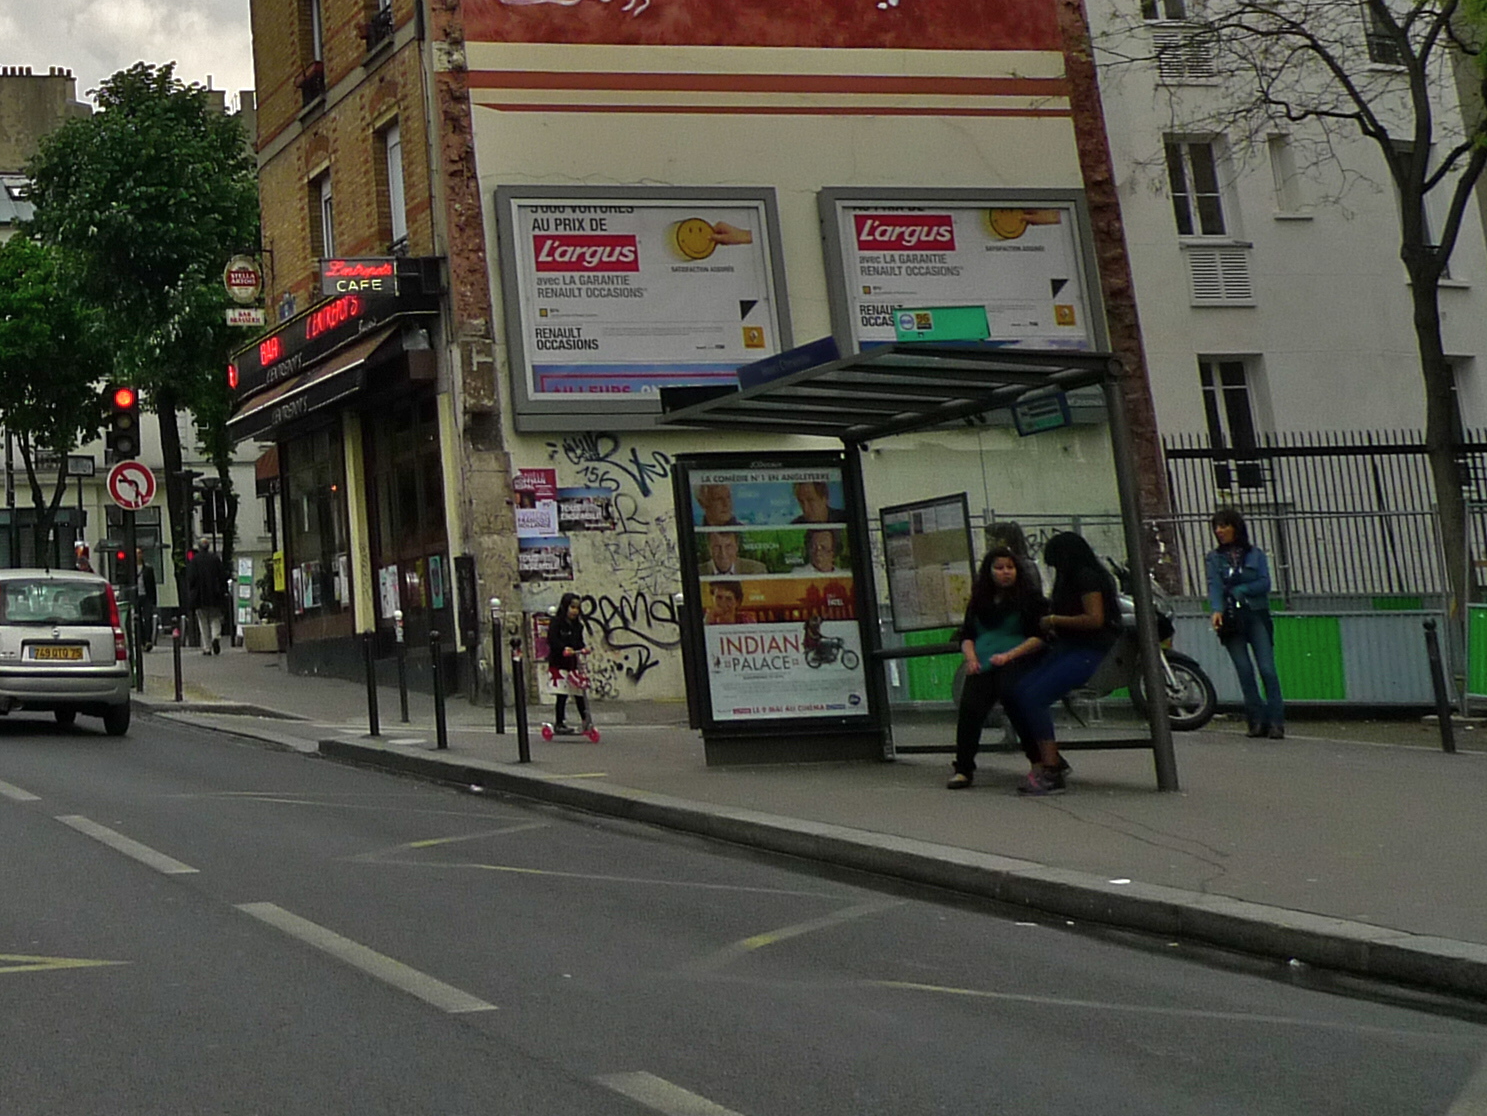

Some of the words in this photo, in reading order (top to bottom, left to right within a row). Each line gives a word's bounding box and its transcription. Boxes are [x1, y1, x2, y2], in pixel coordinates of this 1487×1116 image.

[532, 217, 550, 232] AU
[554, 217, 586, 232] PRIX
[589, 217, 608, 232] DE
[859, 219, 952, 246] L'argus
[537, 239, 636, 267] L'argus
[883, 253, 897, 264] LA
[898, 253, 947, 264] GARANTIE
[860, 265, 903, 276] RENAULT
[336, 279, 383, 292] CAFE
[536, 276, 560, 286] avec
[562, 275, 577, 286] LA
[578, 274, 630, 286] GARANTIE
[537, 287, 583, 298] RENAULT
[859, 304, 903, 315] RENAU
[861, 315, 895, 327] OCCAS
[535, 327, 582, 339] RENAULT
[536, 338, 599, 350] OCCASIONS
[701, 475, 712, 483] LA
[781, 473, 829, 481] ANGLETERRE
[720, 633, 801, 656] INDIAN
[732, 655, 791, 672] PALACE
